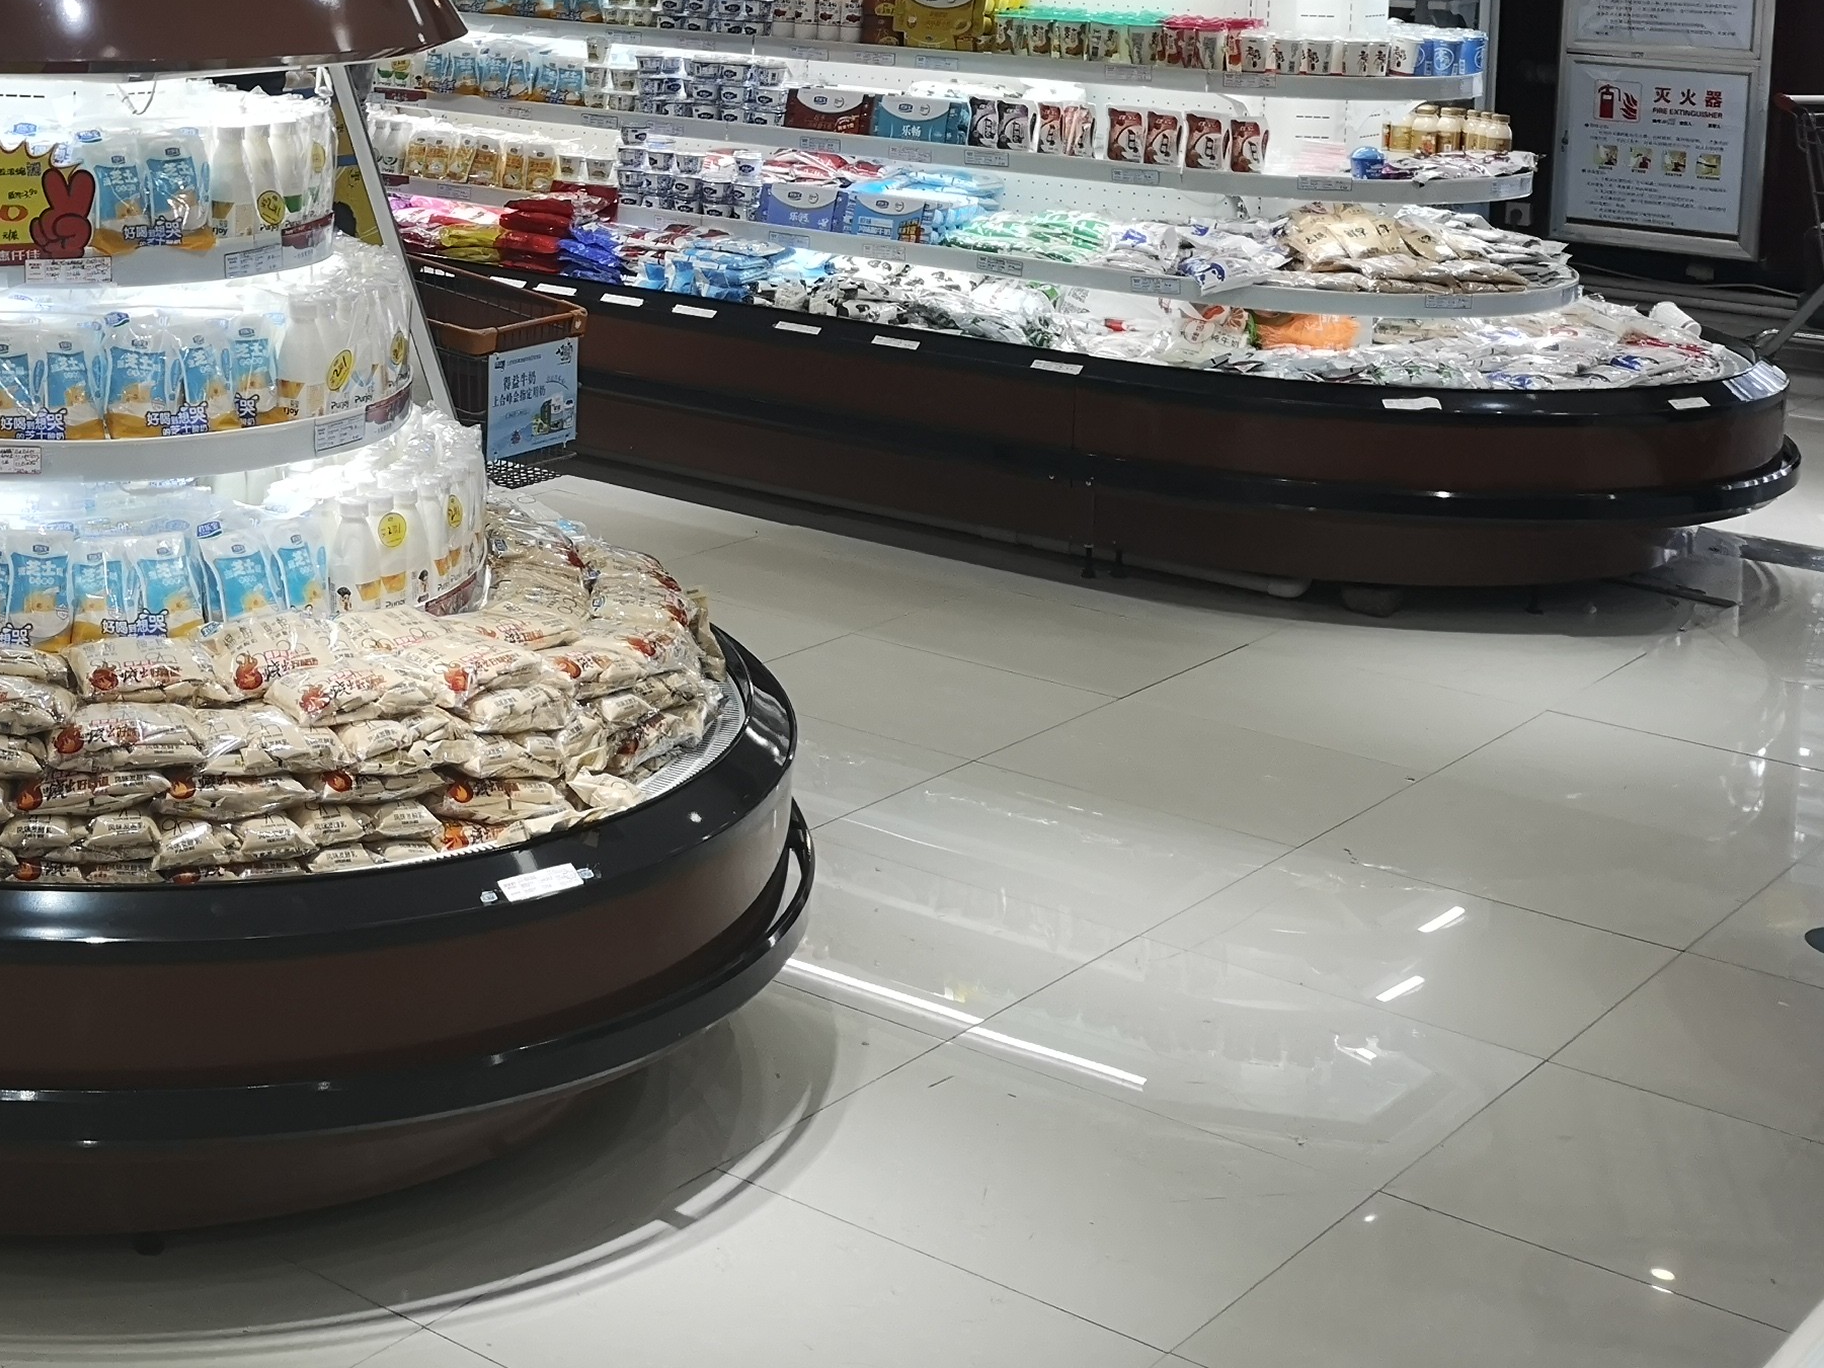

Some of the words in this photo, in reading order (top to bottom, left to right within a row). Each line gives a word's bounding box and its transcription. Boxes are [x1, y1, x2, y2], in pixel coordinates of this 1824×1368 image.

[1653, 87, 1723, 108] 灭火器
[1669, 109, 1723, 119] EXTINGUISHER
[902, 124, 921, 138] 乐畅
[123, 220, 182, 239] 好喝到想哭
[503, 371, 537, 392] 得益牛奶
[492, 384, 547, 408] 上合峰会指定用奶
[0, 411, 65, 431] 好喝到想哭
[146, 406, 209, 427] 好喝到想哭
[101, 614, 168, 635] 好喝到想哭
